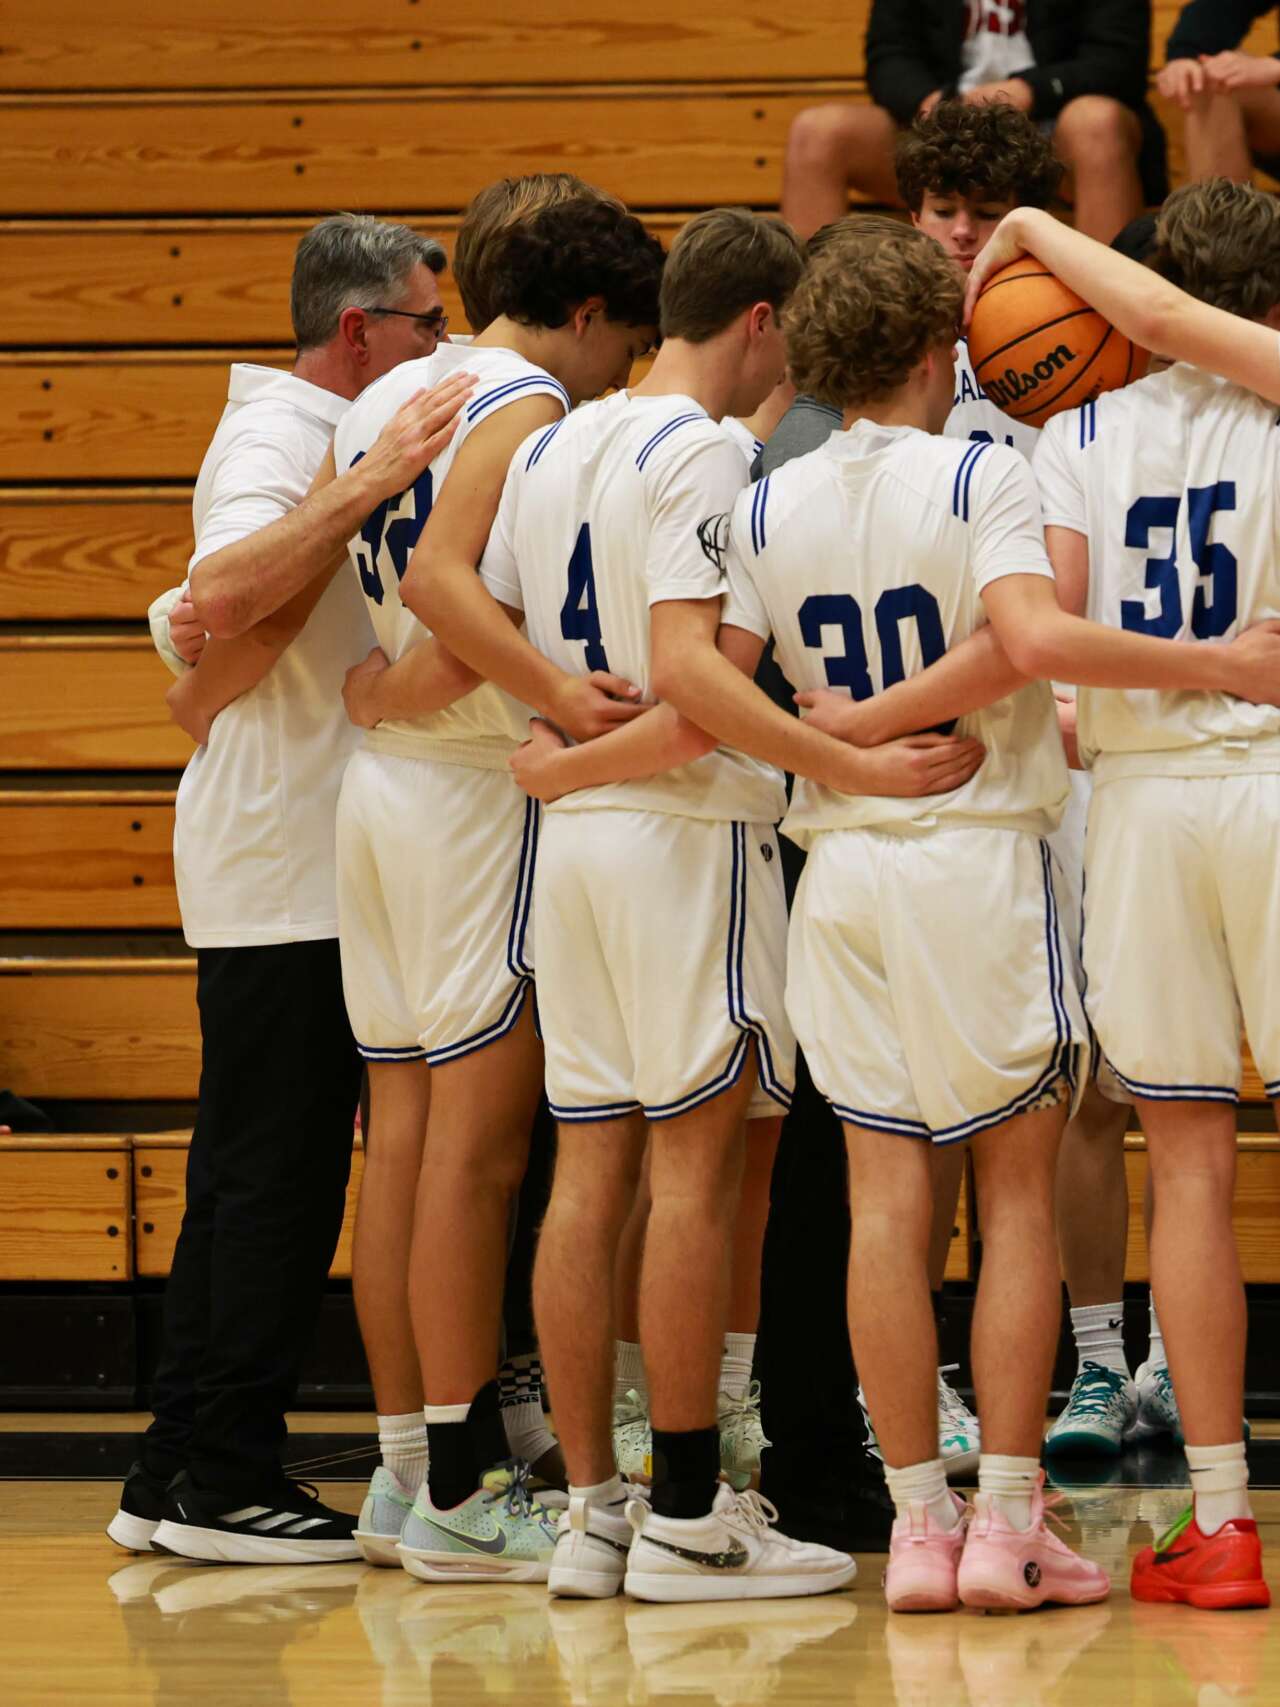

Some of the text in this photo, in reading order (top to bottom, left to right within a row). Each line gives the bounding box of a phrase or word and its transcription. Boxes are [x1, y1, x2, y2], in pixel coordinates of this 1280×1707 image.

[983, 344, 1076, 407] Wilson
[560, 522, 610, 674] 4
[1120, 481, 1237, 640] 35
[798, 583, 962, 737] 30
